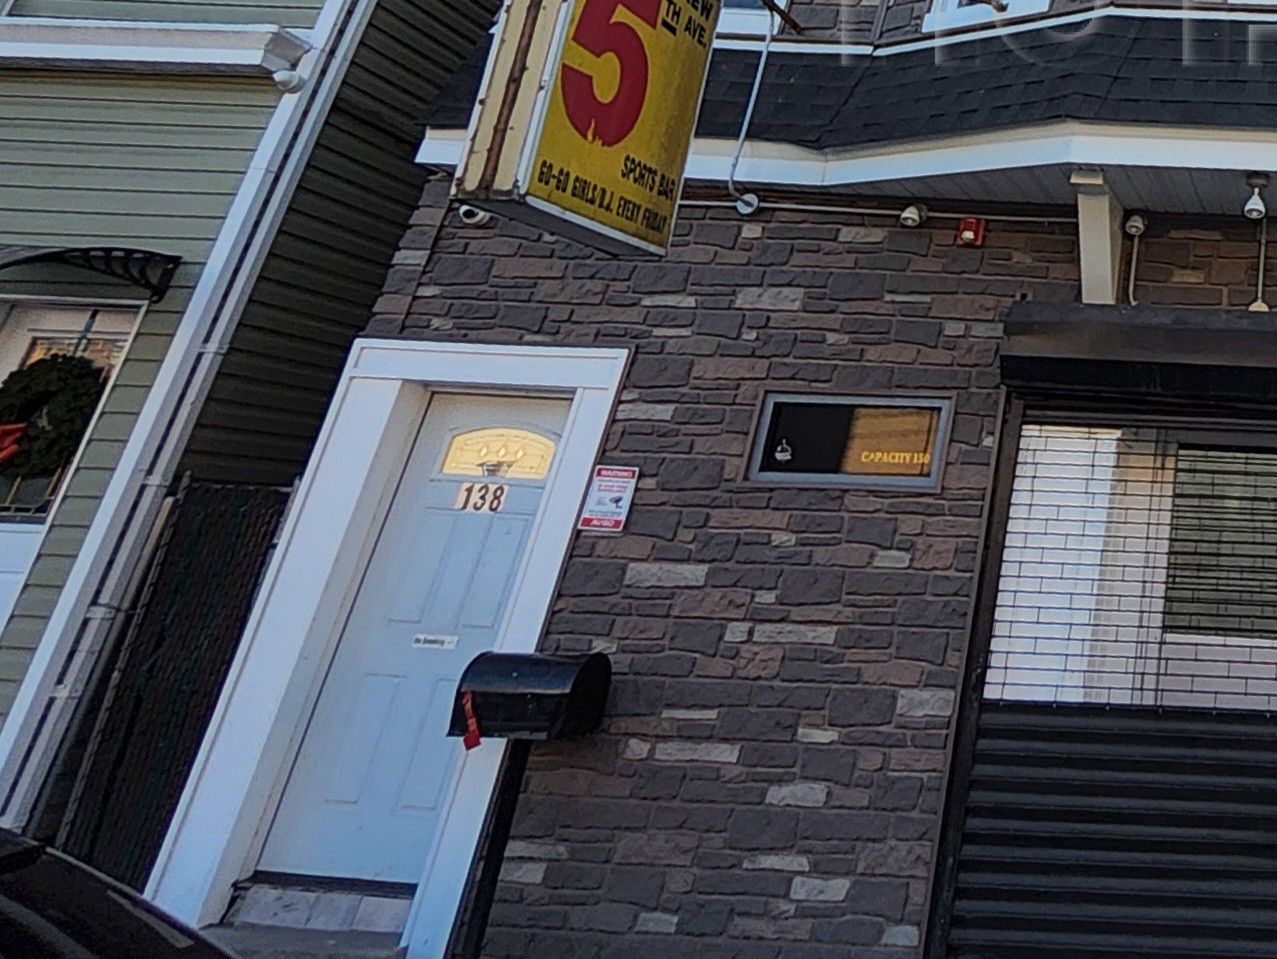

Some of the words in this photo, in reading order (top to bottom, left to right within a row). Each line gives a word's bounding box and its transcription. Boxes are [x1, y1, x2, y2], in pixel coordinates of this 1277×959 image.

[683, 16, 707, 49] AVE.
[537, 159, 571, 193] GO-GO
[571, 174, 598, 206] GIRLS
[621, 154, 657, 193] SPORTS
[657, 172, 676, 201] BAR
[861, 451, 912, 464] CAPACITY
[459, 482, 505, 512] 138
